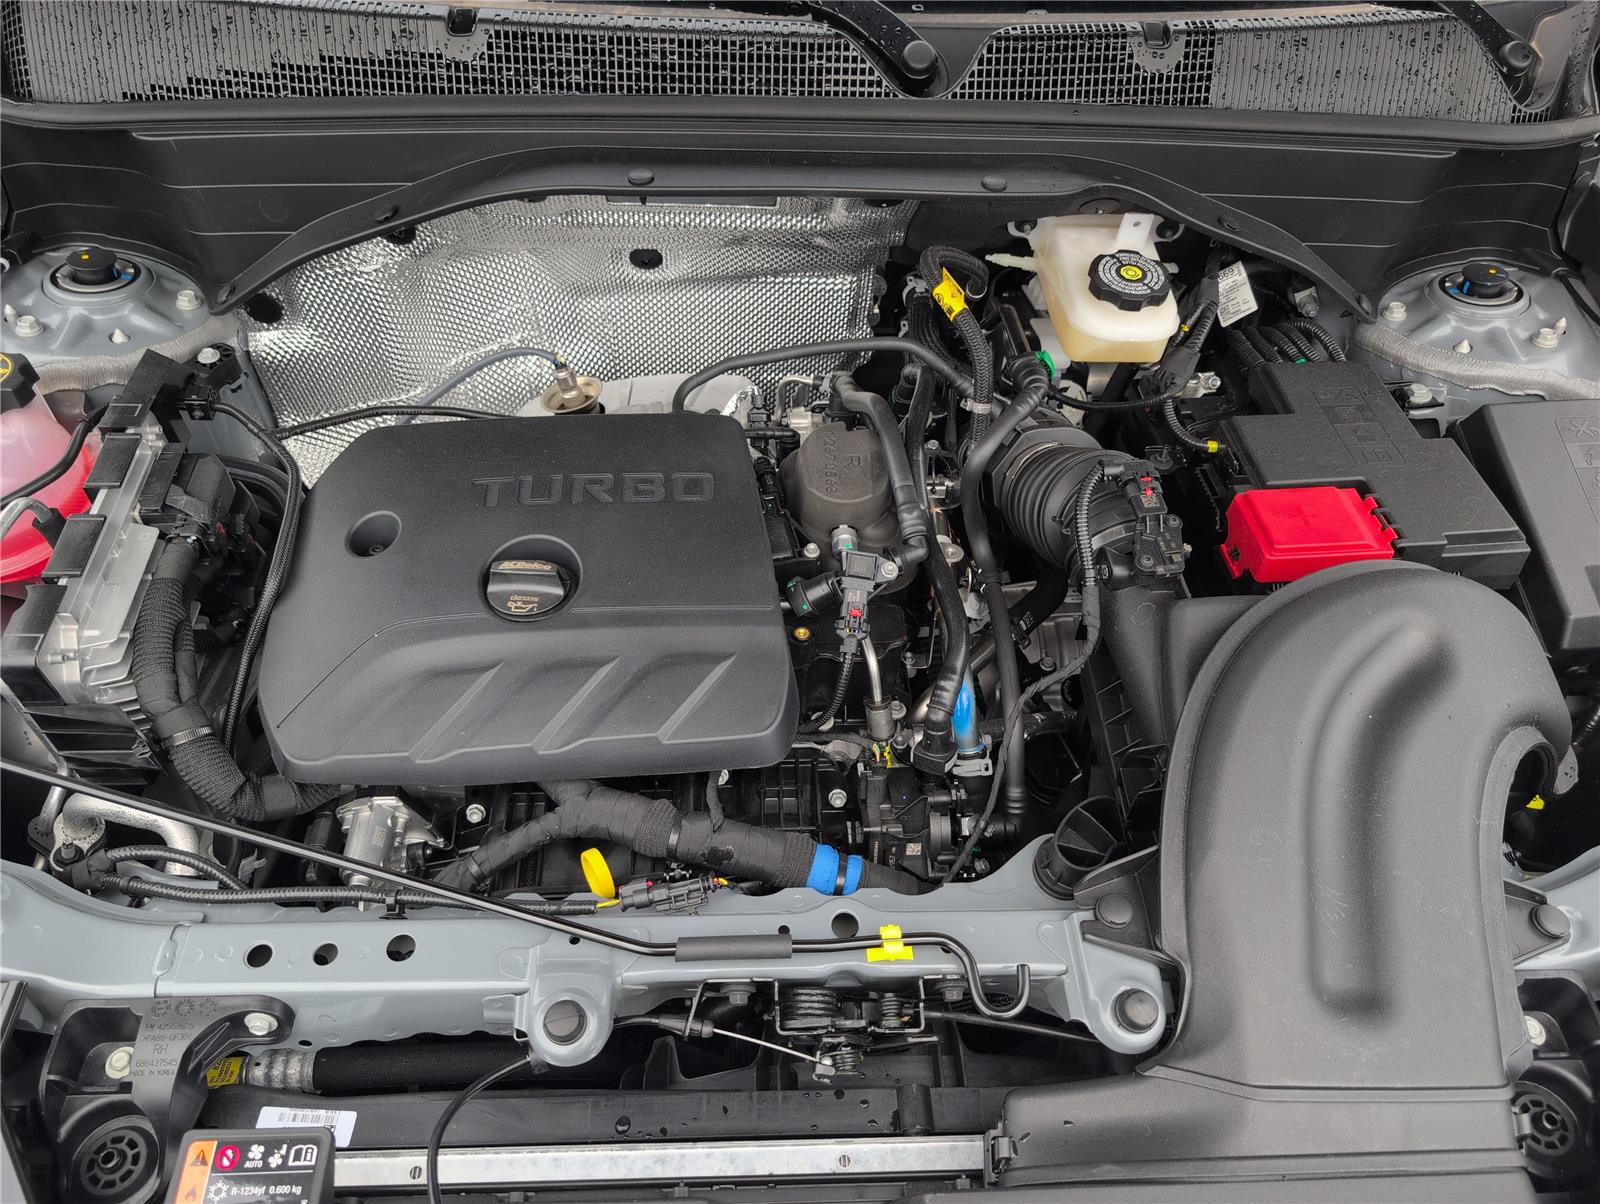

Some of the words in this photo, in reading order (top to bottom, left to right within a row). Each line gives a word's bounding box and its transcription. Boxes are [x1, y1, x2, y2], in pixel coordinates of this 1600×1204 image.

[472, 472, 714, 507] TURBO
[153, 1044, 168, 1054] RH
[244, 1160, 263, 1168] AUTO
[231, 1186, 266, 1196] R-1234yf
[269, 1185, 291, 1194] 0.600
[291, 1185, 302, 1195] kg
